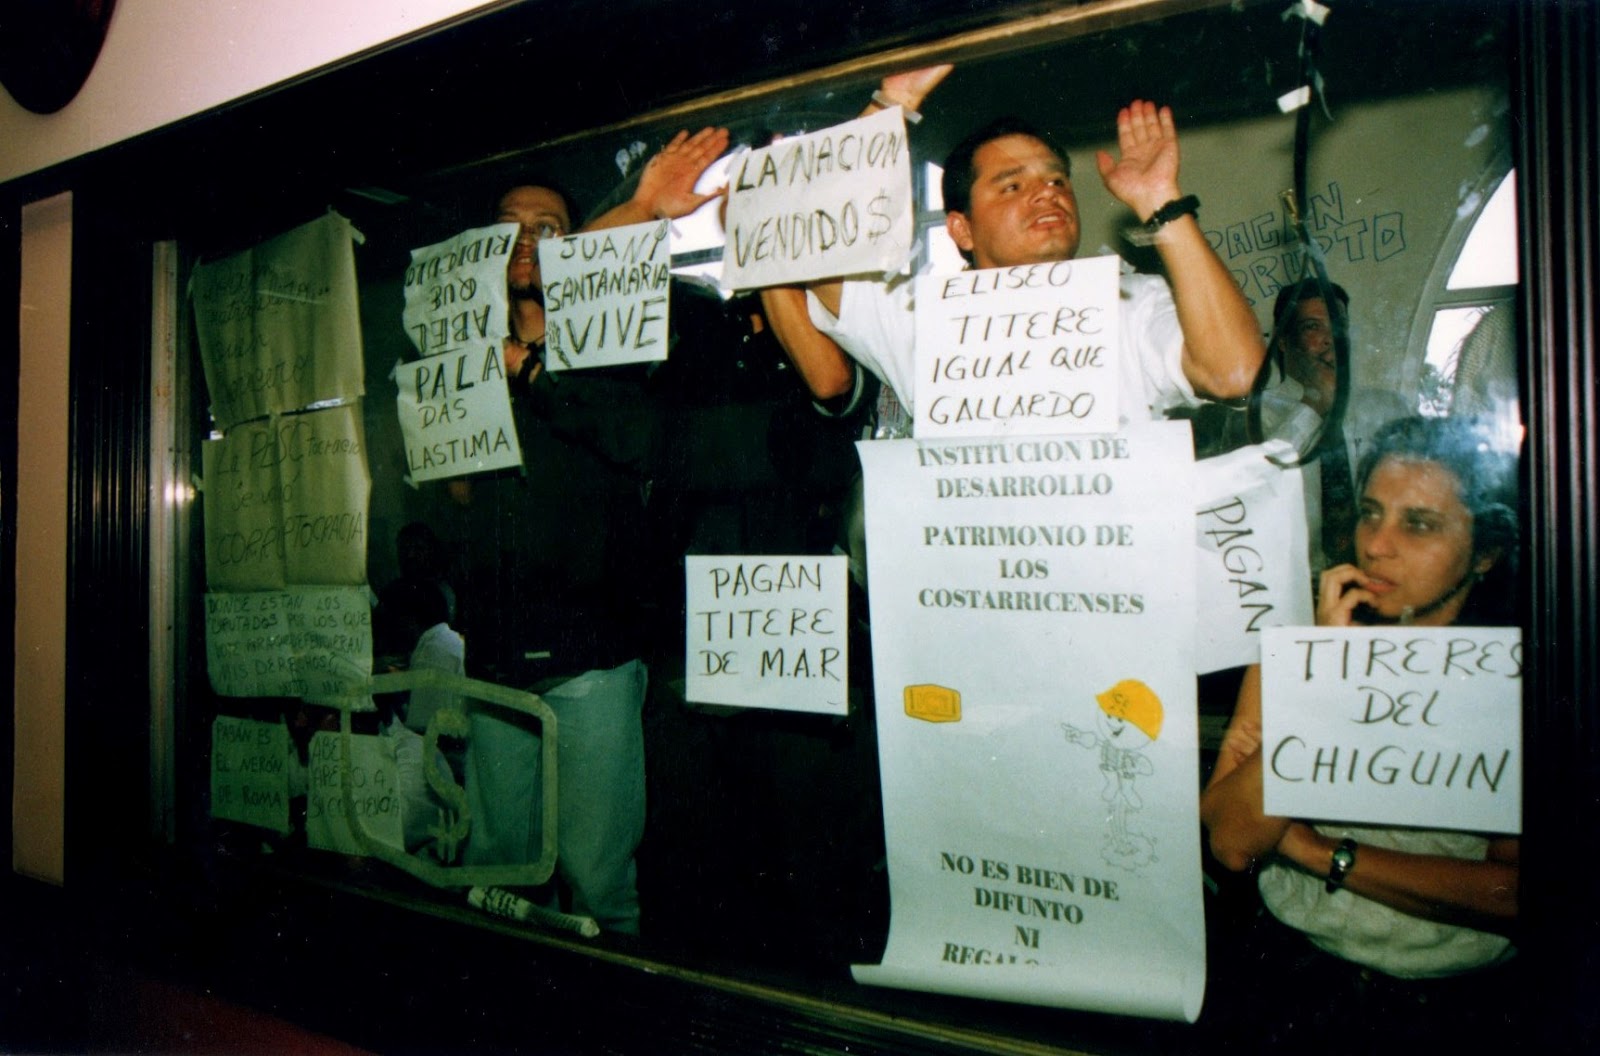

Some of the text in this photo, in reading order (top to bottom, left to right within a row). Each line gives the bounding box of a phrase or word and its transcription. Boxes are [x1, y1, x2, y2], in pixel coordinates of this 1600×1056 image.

[735, 131, 901, 192] LA NACION
[406, 234, 512, 287] RIDICULO
[560, 235, 649, 263] JUAN
[430, 277, 477, 312] QUE
[545, 262, 669, 312] SANTAMARIA
[942, 262, 1072, 299] ELISEO
[412, 304, 491, 352] ABEL
[565, 296, 667, 355] VIVE
[951, 307, 1103, 344] TITERE
[933, 346, 1105, 383] IGUAL QUE
[418, 399, 467, 429] DAS
[929, 391, 1095, 425] GALLARDO
[409, 427, 511, 471] LASTIMA
[917, 438, 1130, 467] INSTITUCION DE
[936, 473, 1113, 499] DESARROLLO
[923, 524, 1134, 547] PATRIMONIO DE
[709, 562, 822, 599] PAGAN
[999, 558, 1049, 580] LOS
[1196, 496, 1274, 632] PAGAN
[918, 588, 1145, 615] COSTARRICENSES
[695, 608, 834, 641] TITERE
[698, 647, 841, 682] DE M.A.R
[1294, 638, 1522, 681] TIRERES
[1350, 685, 1441, 727] DEL
[312, 765, 366, 788] APEO
[1271, 735, 1510, 792] CHIGUIN
[940, 851, 1120, 902] NO ES BIEN DE
[974, 887, 1084, 926] DIFUNTO
[1015, 925, 1040, 949] NI
